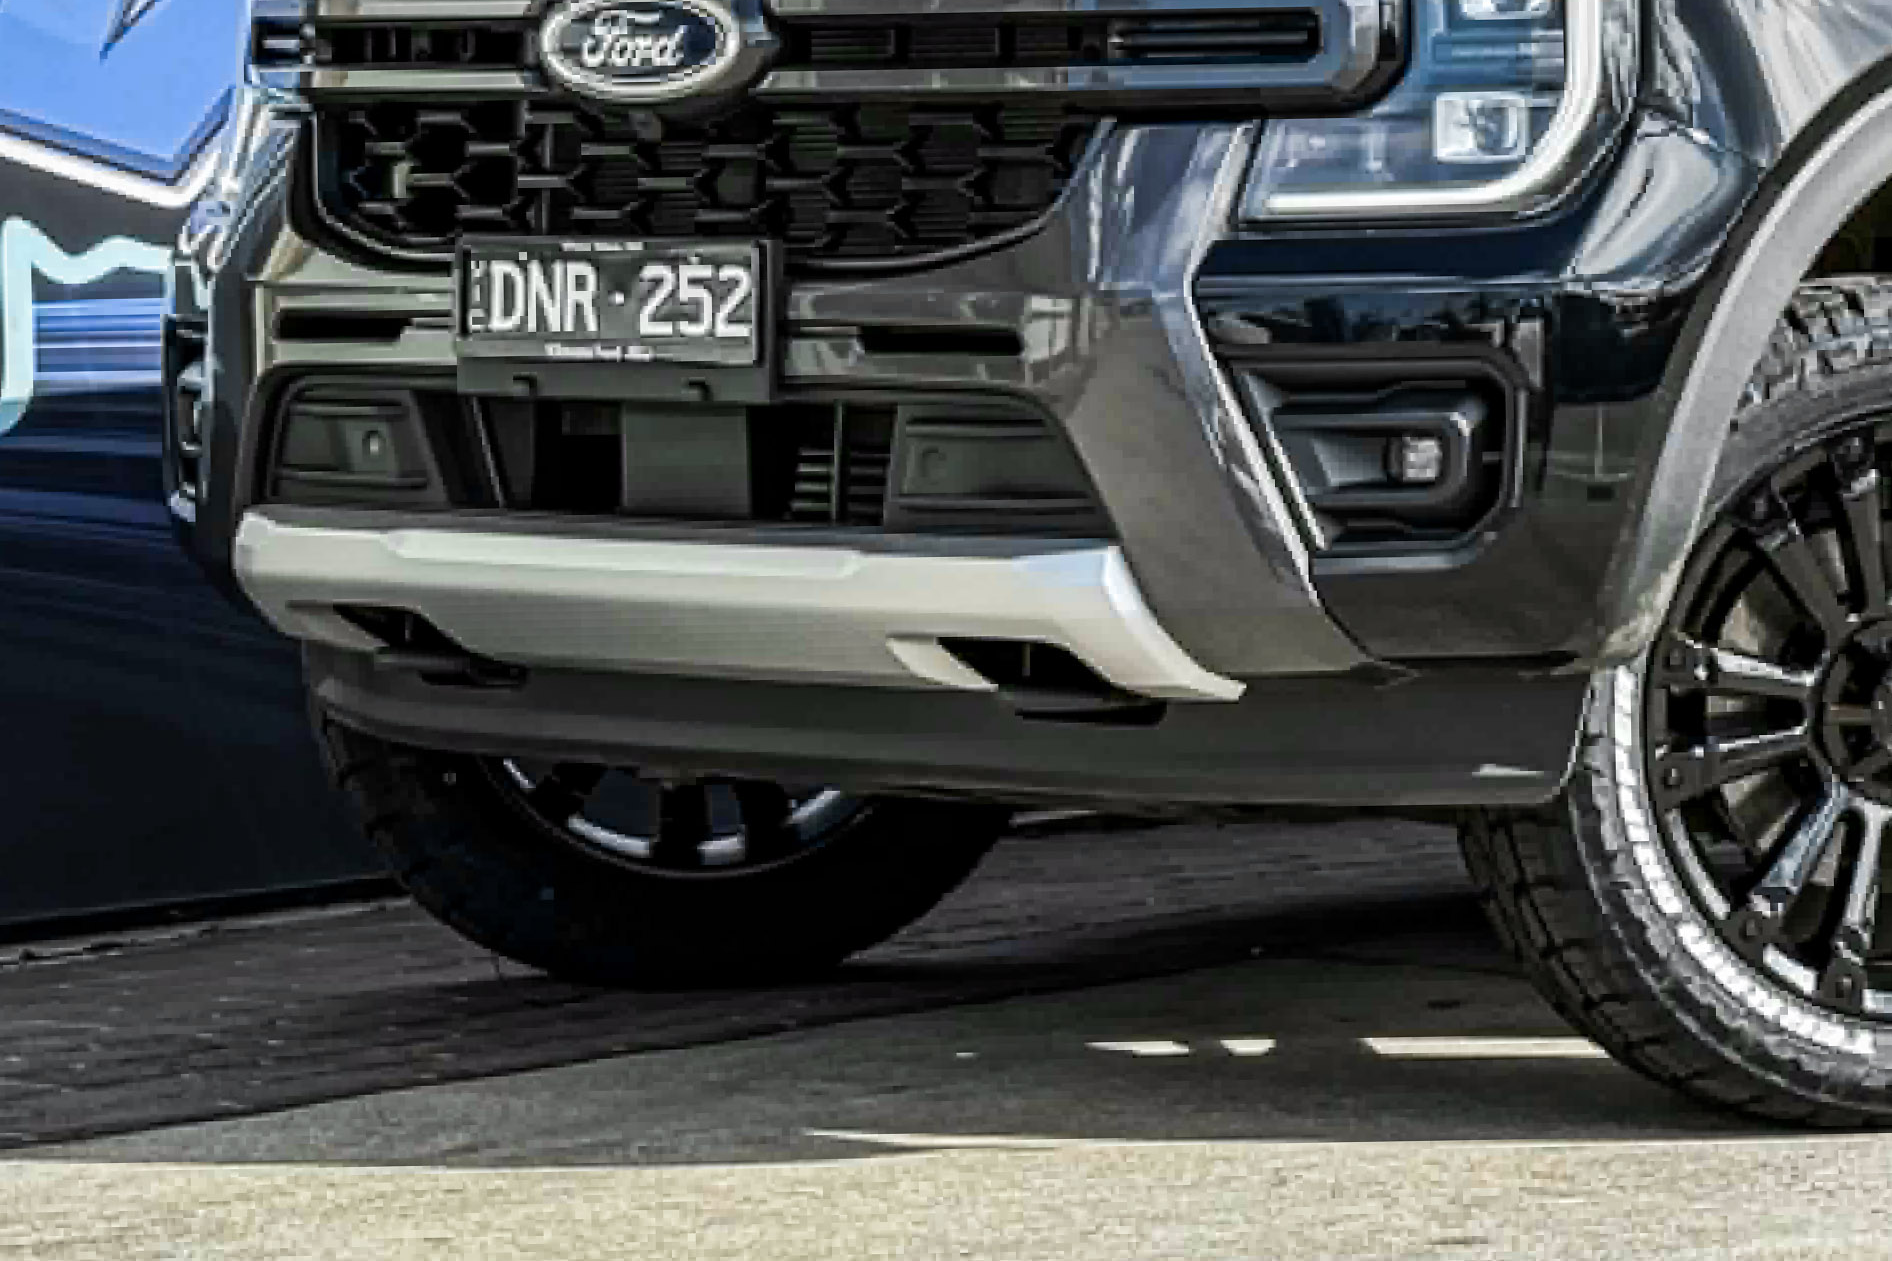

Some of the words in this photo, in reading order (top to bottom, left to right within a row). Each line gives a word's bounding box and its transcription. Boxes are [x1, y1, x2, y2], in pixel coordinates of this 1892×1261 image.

[580, 8, 690, 69] Ford
[487, 258, 599, 333] DNR
[638, 263, 753, 338] 252
